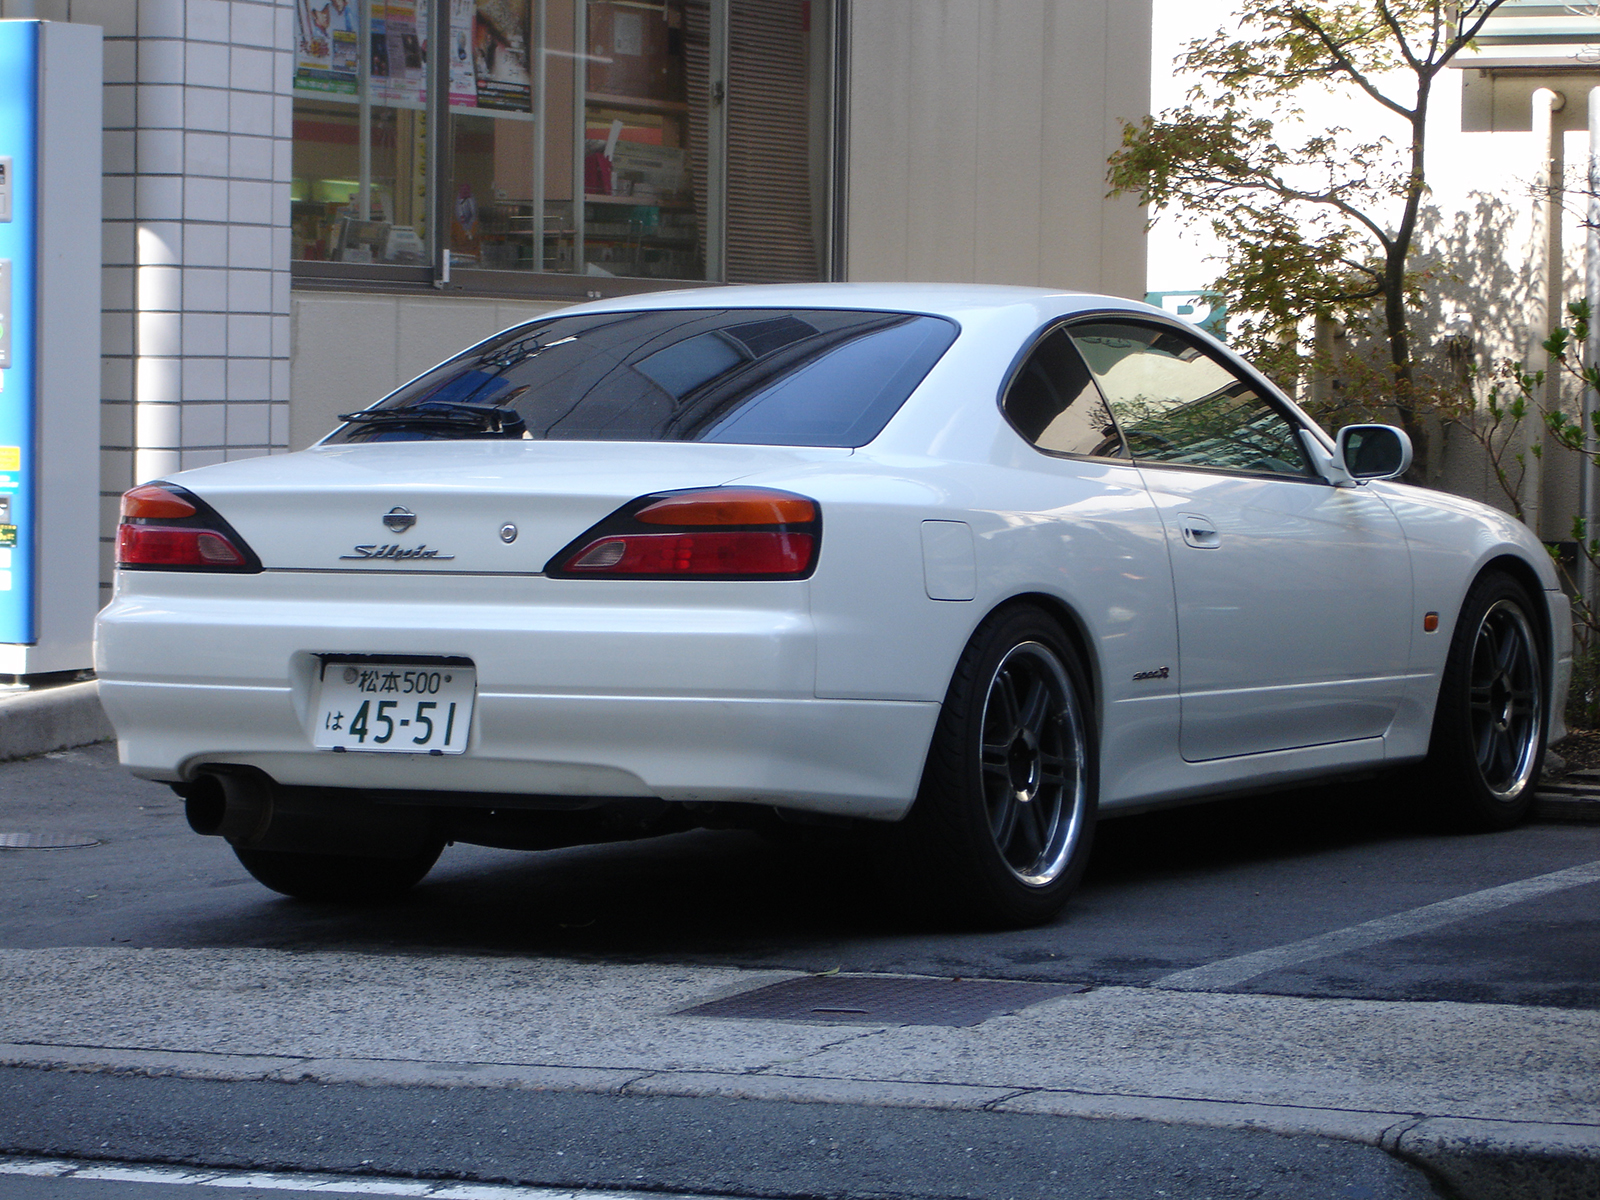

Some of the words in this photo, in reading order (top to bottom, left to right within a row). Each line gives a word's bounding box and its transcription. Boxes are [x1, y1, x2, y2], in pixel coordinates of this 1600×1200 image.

[339, 543, 455, 562] Silvia
[325, 710, 345, 731] は
[349, 699, 457, 746] 45-51
